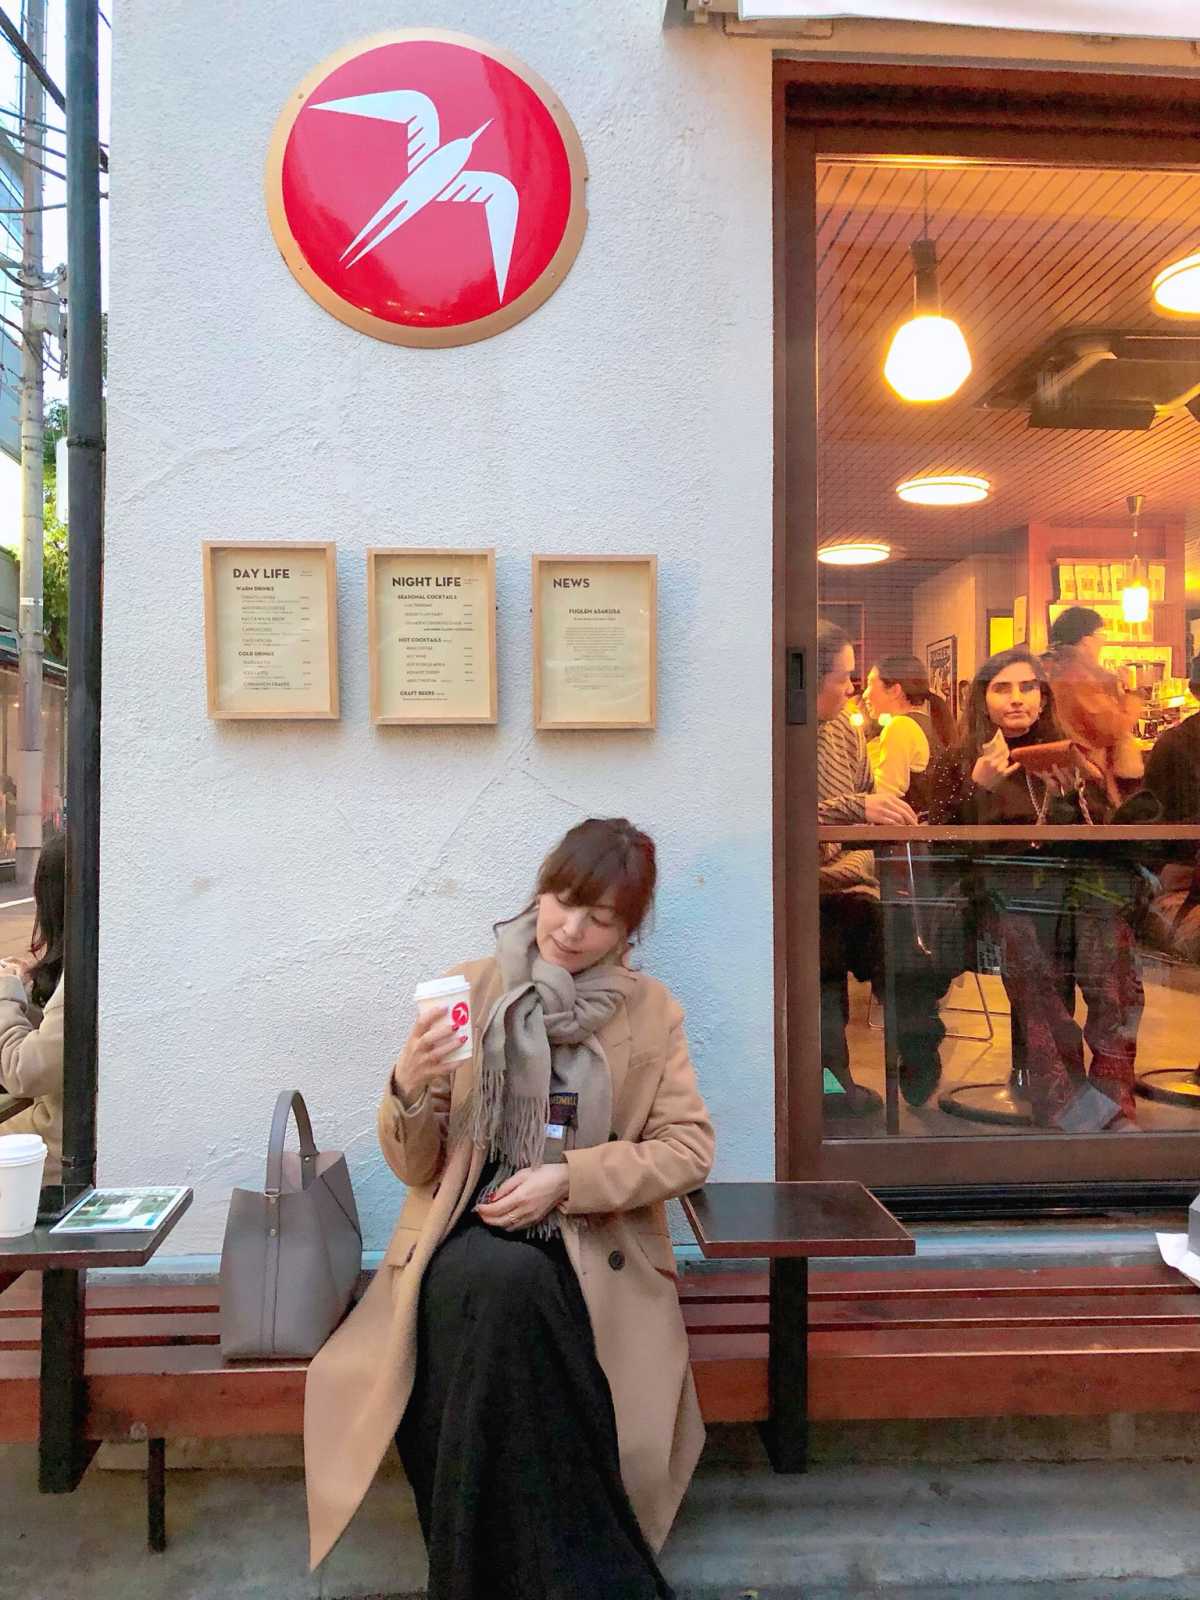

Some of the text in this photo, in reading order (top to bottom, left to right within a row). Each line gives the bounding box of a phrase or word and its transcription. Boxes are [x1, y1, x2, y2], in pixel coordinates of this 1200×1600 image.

[232, 568, 260, 579] DAY
[263, 568, 291, 579] LIFE
[392, 576, 433, 588] NIGHT
[435, 577, 462, 588] LIFE
[553, 577, 591, 589] NEWS
